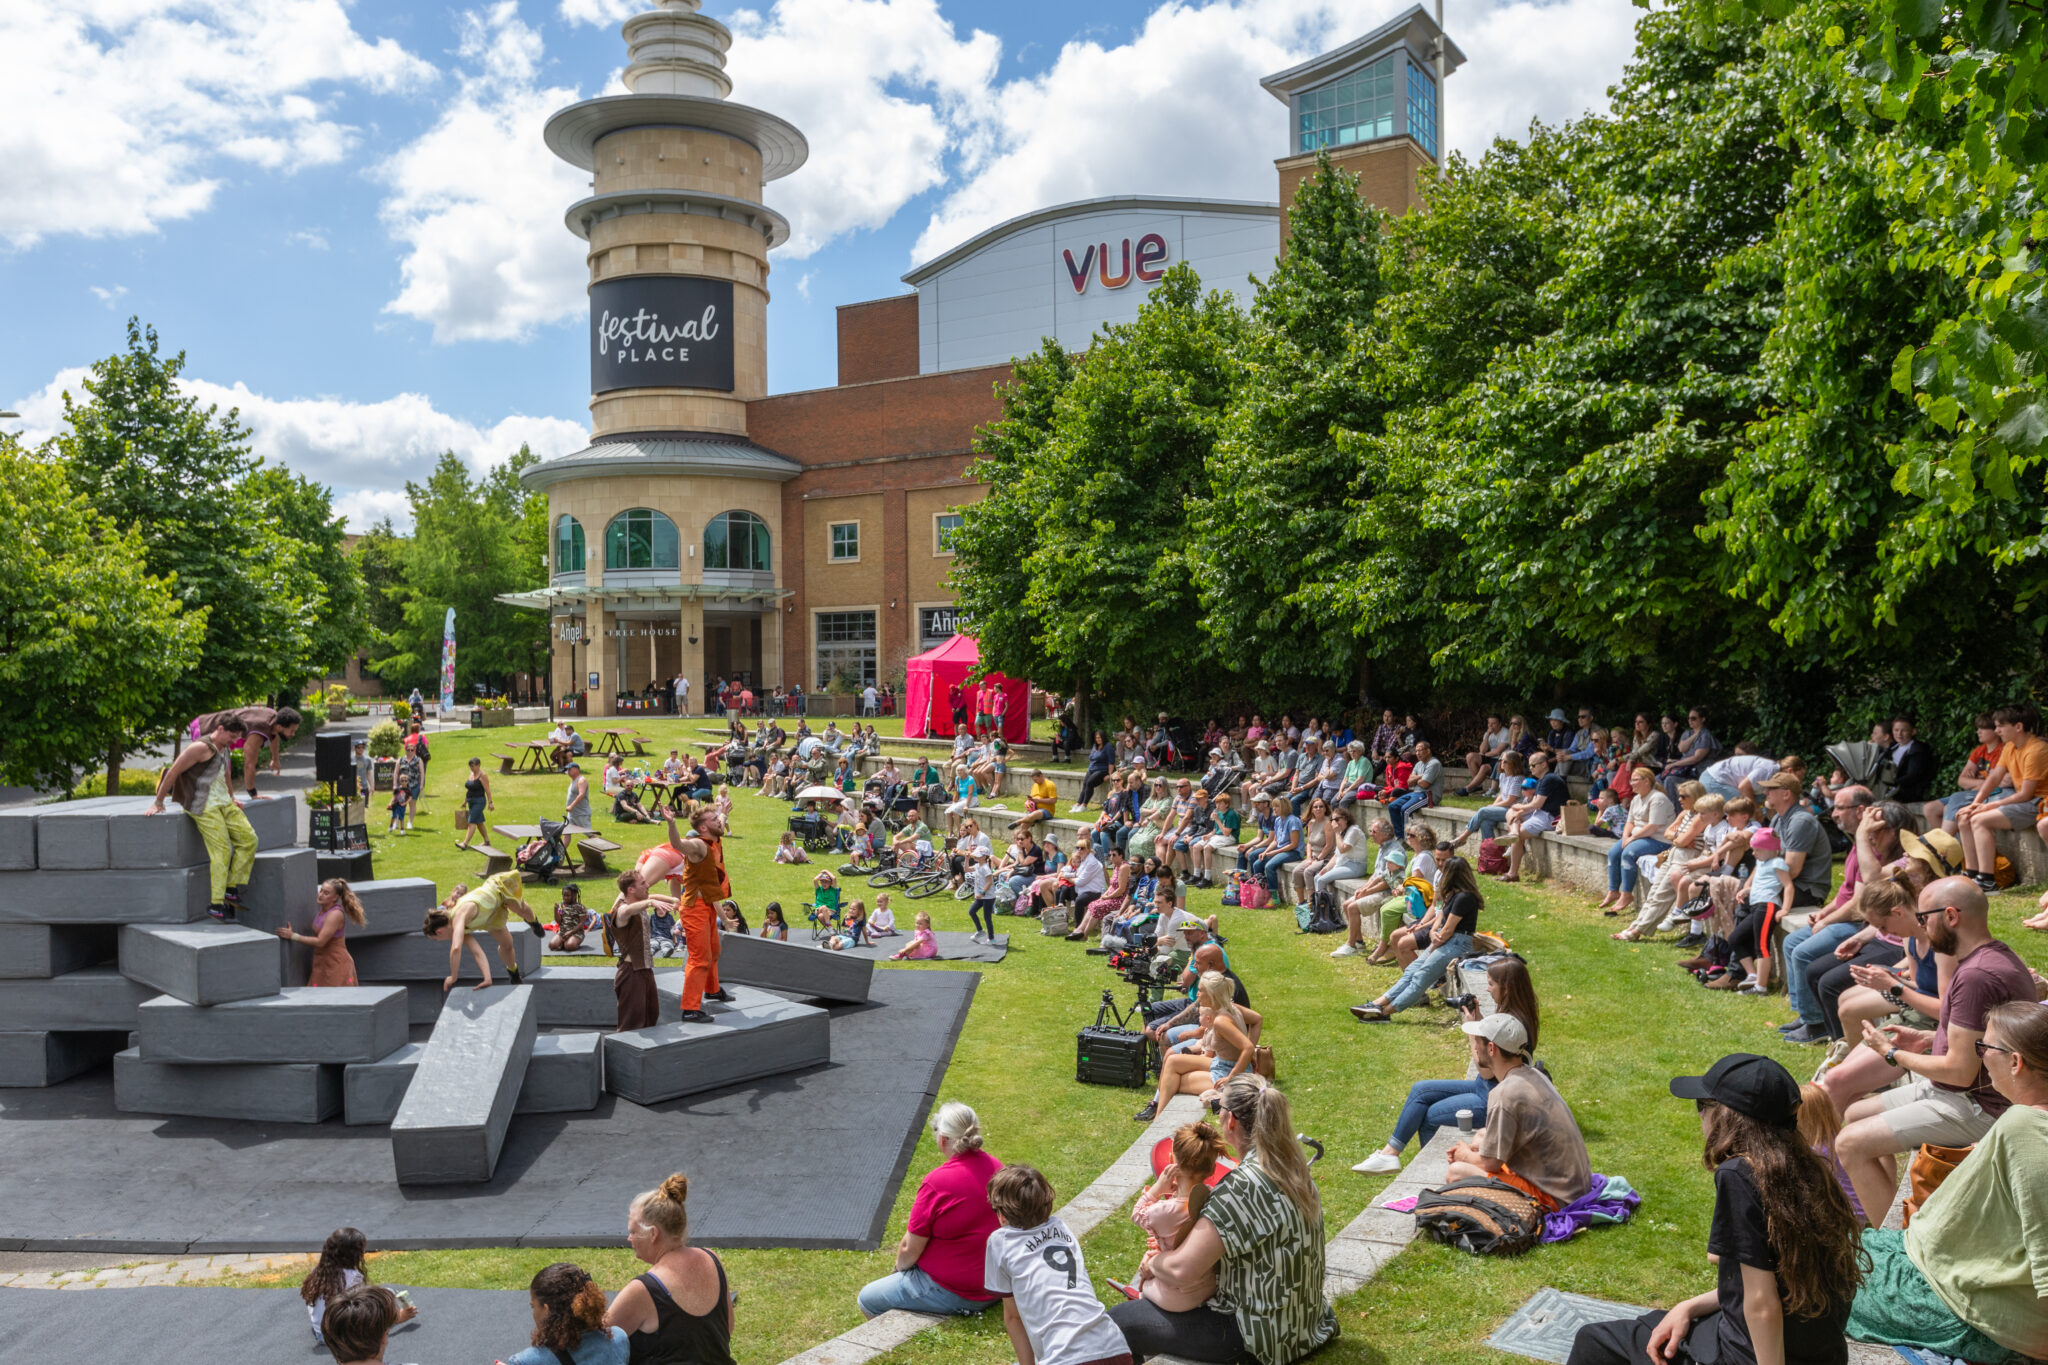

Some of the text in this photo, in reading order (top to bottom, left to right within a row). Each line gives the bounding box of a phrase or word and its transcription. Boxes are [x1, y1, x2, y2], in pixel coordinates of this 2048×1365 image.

[1062, 232, 1168, 294] vue
[599, 304, 719, 355] festival
[618, 348, 689, 364] PLACE
[560, 621, 583, 645] Angel
[609, 628, 677, 637] FREE HOUSE
[1025, 1227, 1072, 1252] HAALAND
[1043, 1245, 1077, 1290] 9
